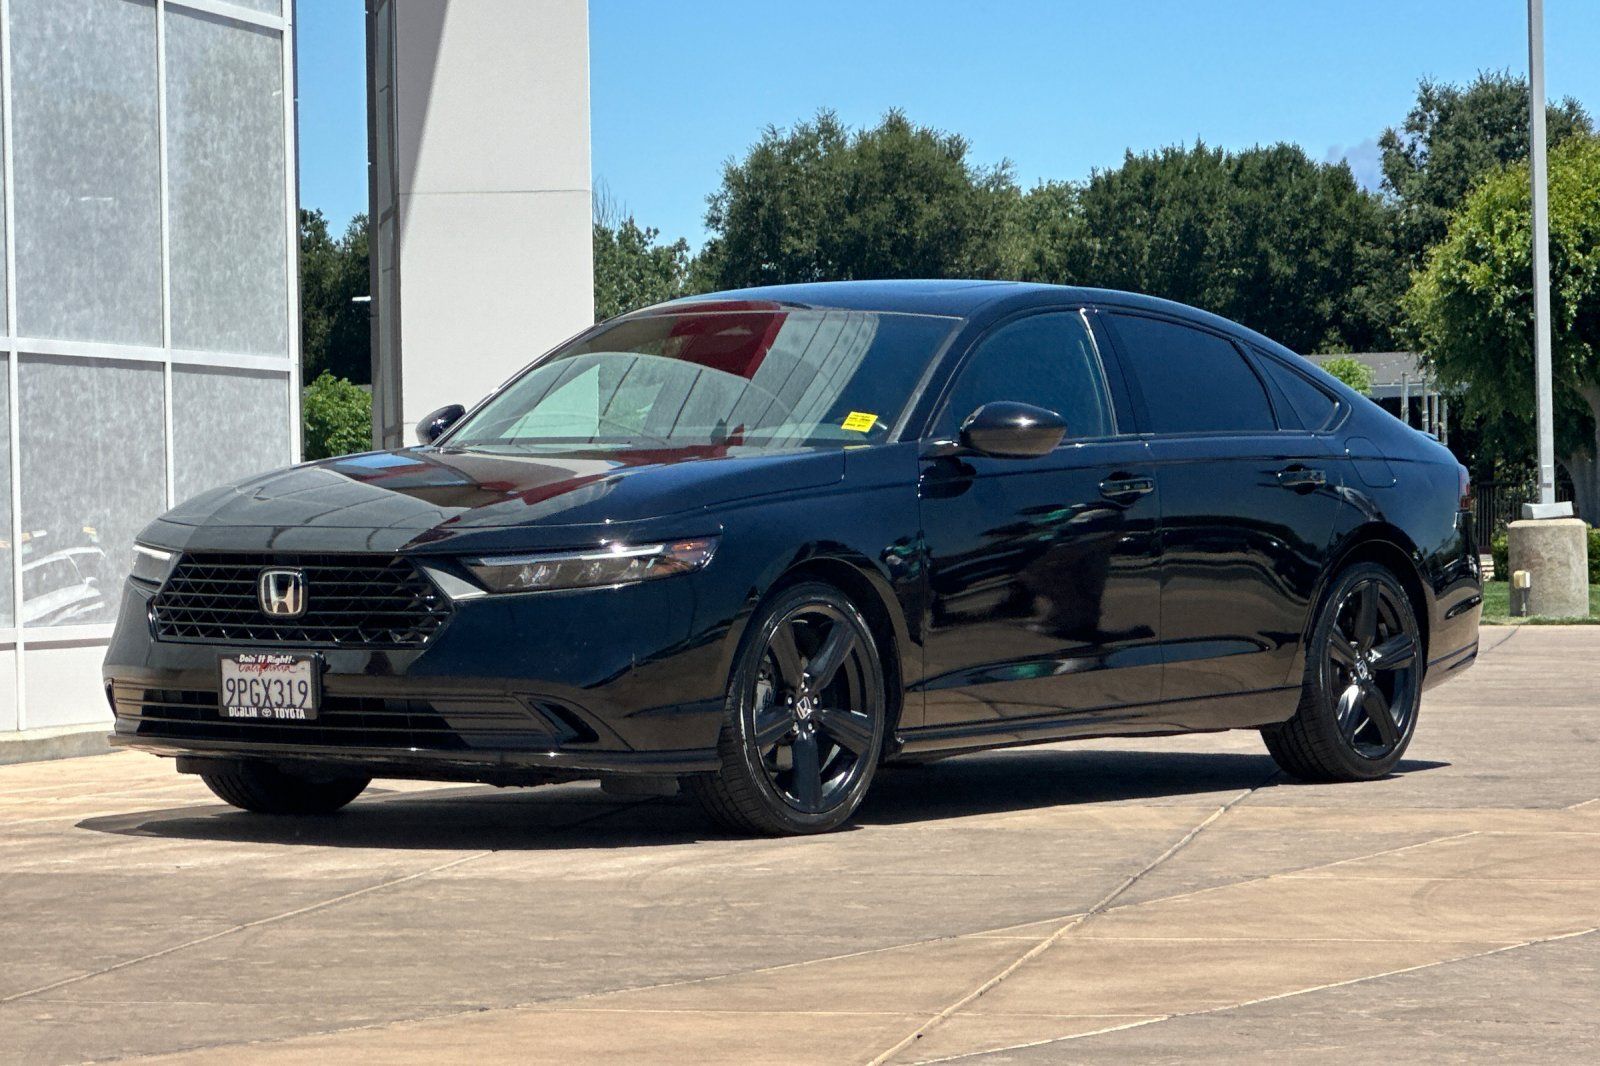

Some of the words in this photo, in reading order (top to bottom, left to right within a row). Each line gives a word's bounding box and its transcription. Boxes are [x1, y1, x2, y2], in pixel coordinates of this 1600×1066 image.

[258, 654, 266, 663] It
[267, 655, 293, 665] Right!
[226, 678, 308, 709] 9PGX319
[228, 706, 257, 717] DUBLIN
[274, 708, 305, 719] TOYOTA
